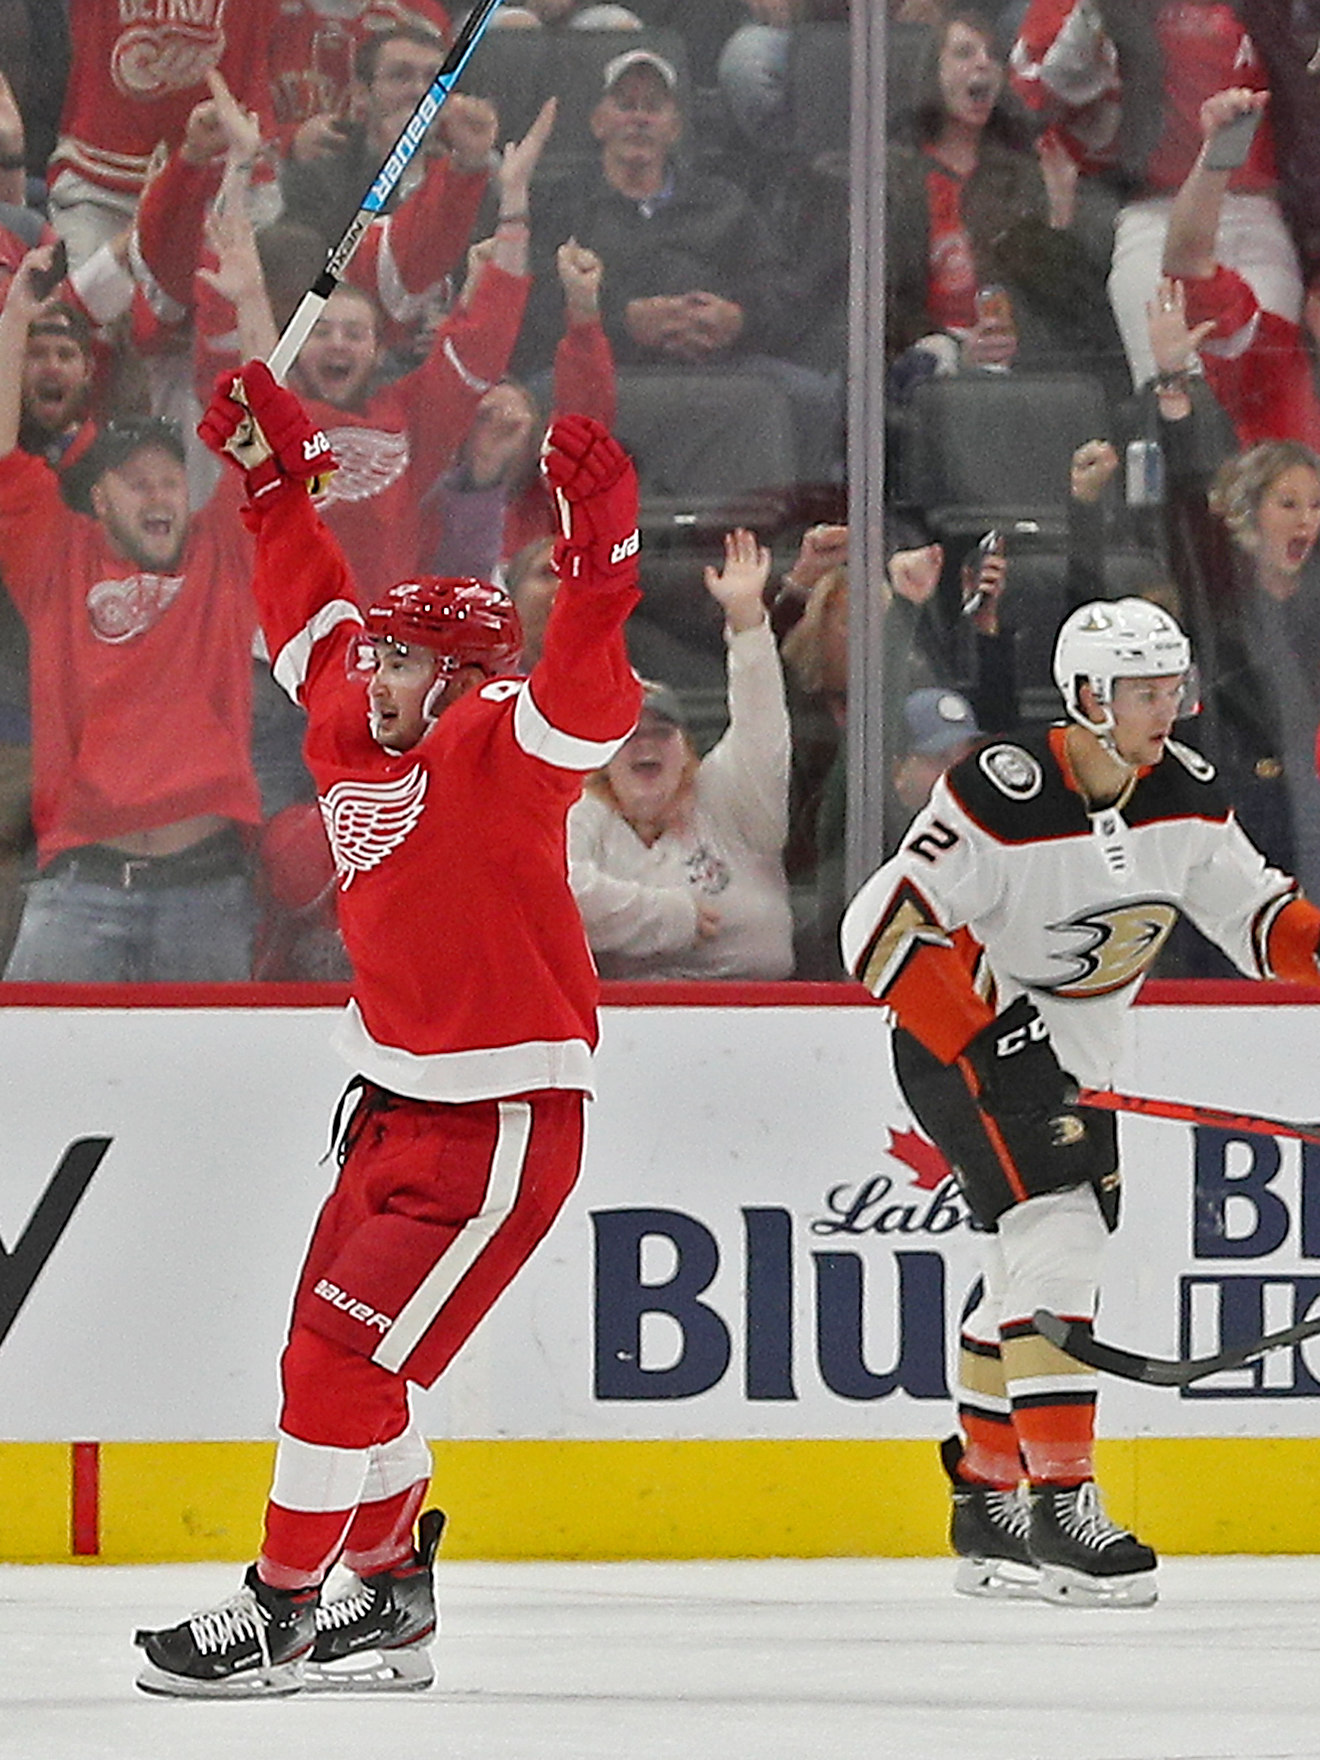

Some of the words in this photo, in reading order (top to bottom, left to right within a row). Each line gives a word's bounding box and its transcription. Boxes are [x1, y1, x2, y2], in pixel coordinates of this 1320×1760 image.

[370, 92, 446, 204] BAUER
[314, 1279, 393, 1334] BAUER
[588, 1207, 985, 1401] Blu
